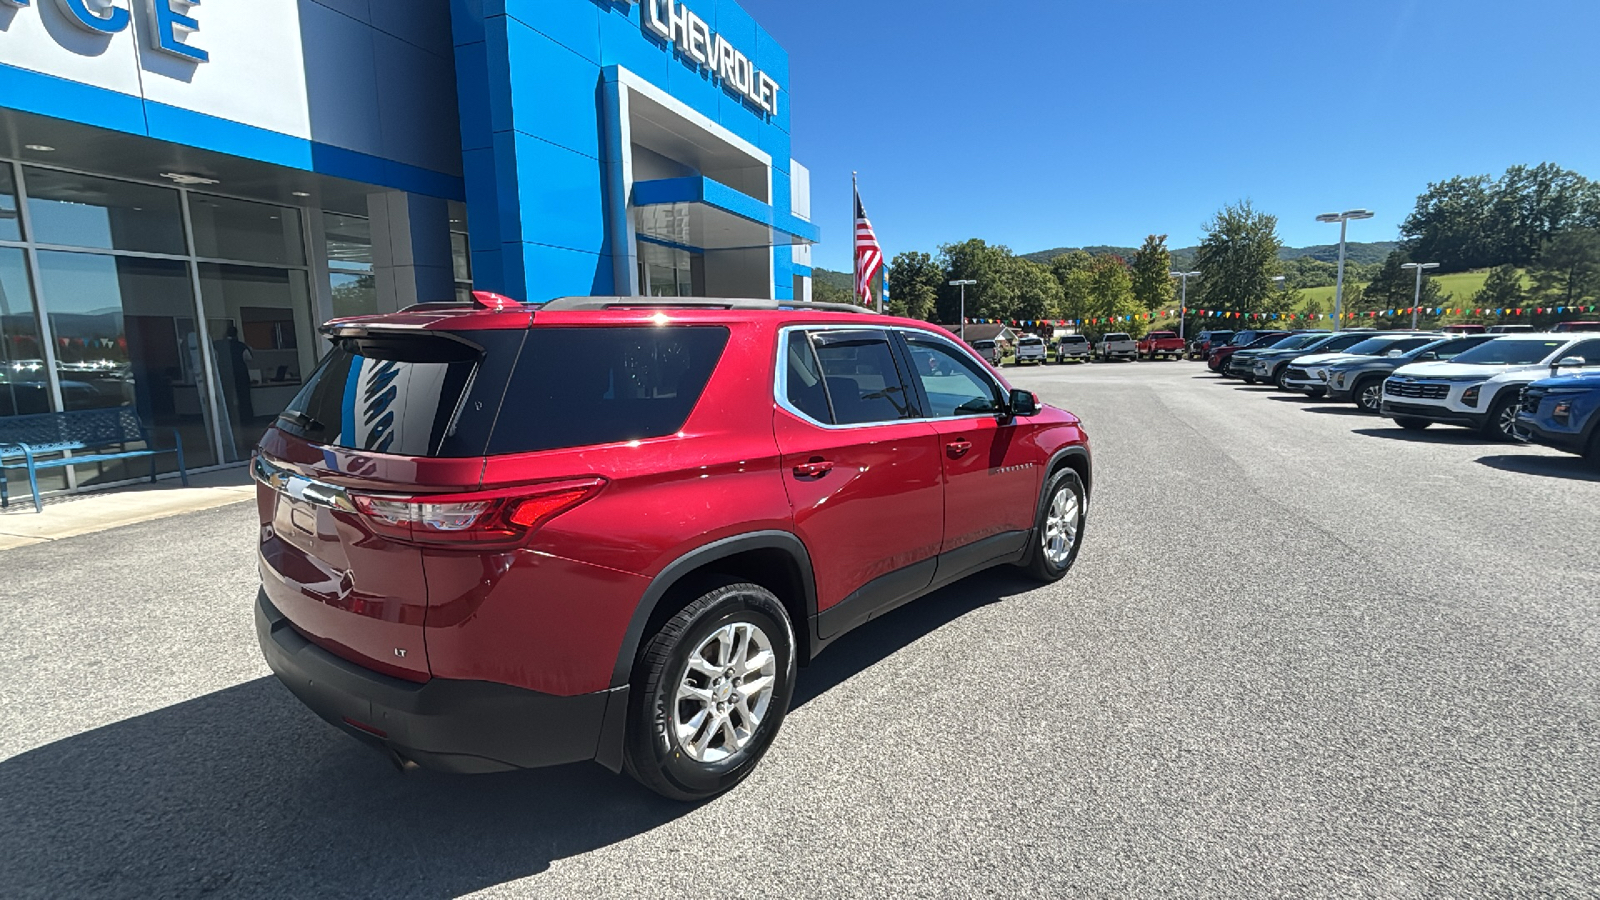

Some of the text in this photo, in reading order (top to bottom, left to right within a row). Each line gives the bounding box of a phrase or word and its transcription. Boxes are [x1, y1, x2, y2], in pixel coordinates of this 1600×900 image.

[0, 0, 210, 63] CE
[645, 0, 779, 116] CHEVROLET
[394, 647, 407, 658] LT
